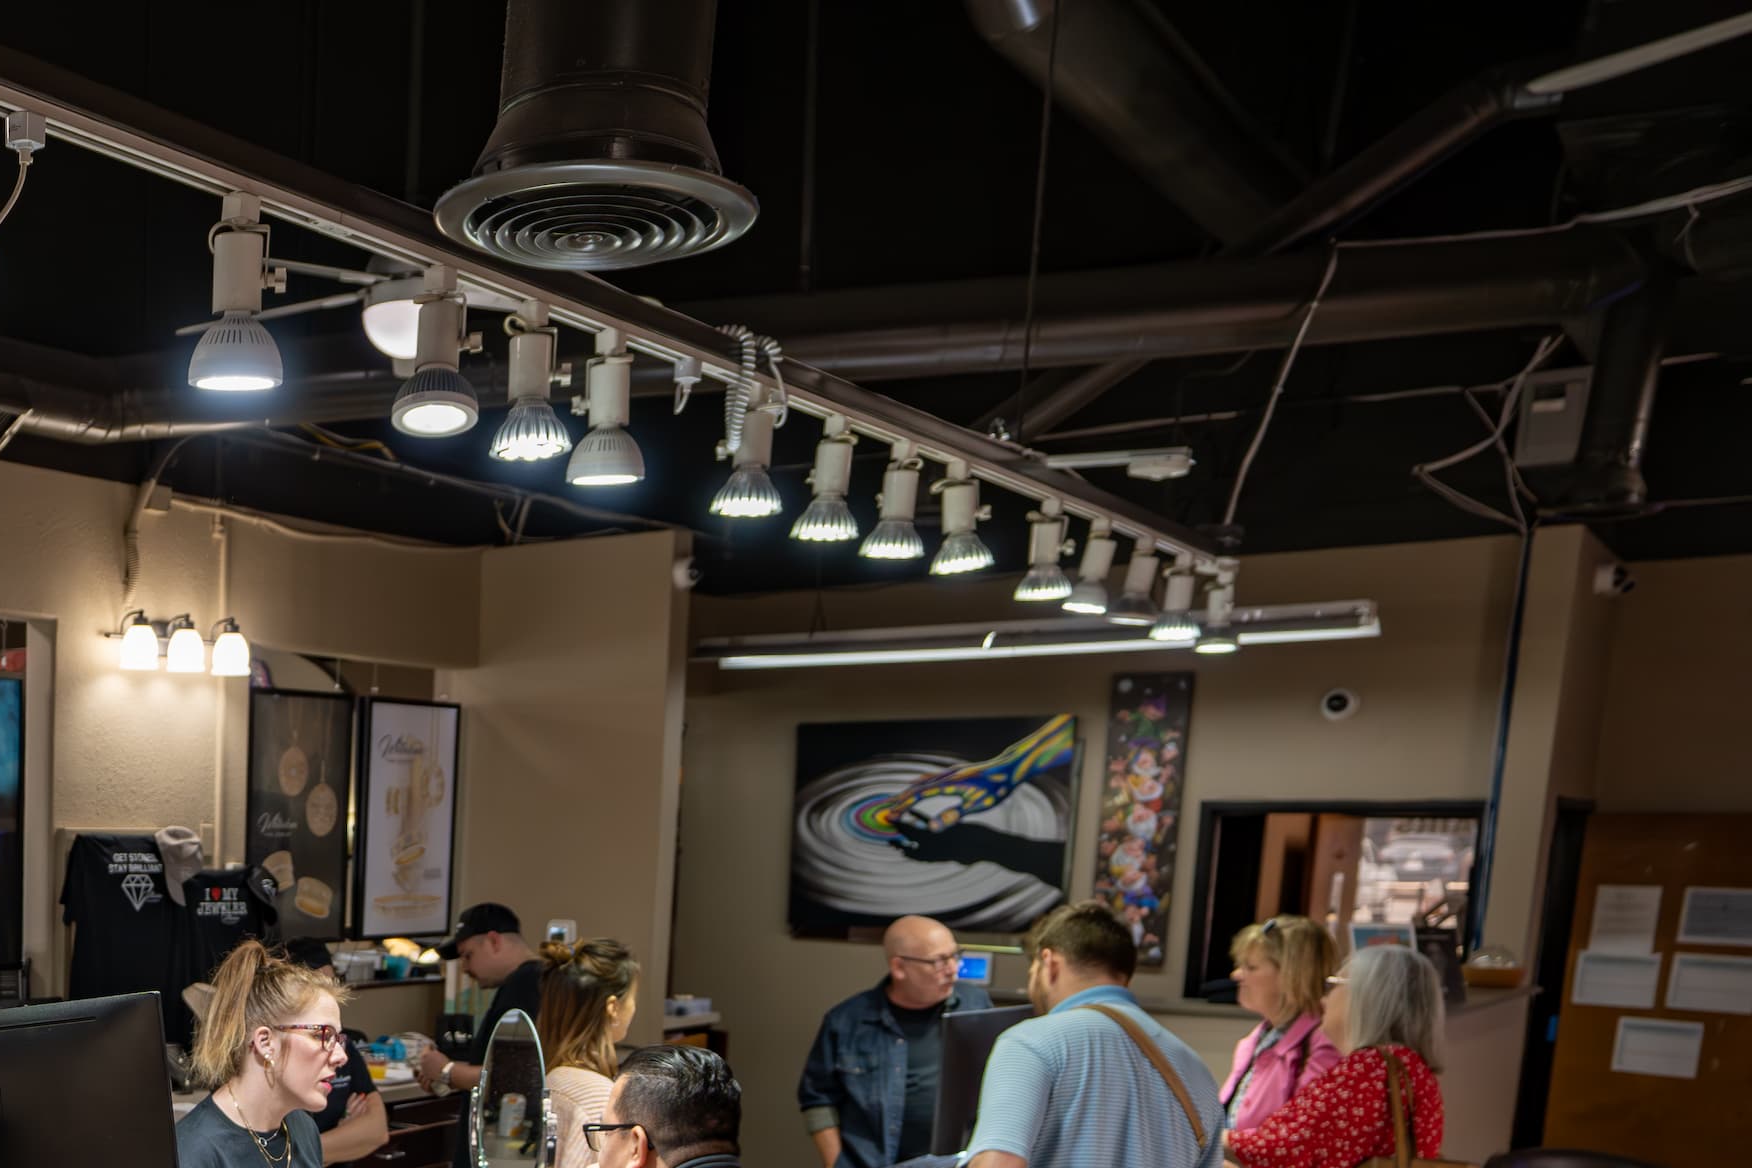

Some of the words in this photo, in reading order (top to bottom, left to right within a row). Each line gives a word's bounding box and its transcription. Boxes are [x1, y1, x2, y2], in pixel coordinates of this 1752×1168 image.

[112, 852, 128, 863] GET
[108, 863, 128, 874] STAY
[222, 887, 239, 901] MY
[197, 901, 248, 916] JEWELER
